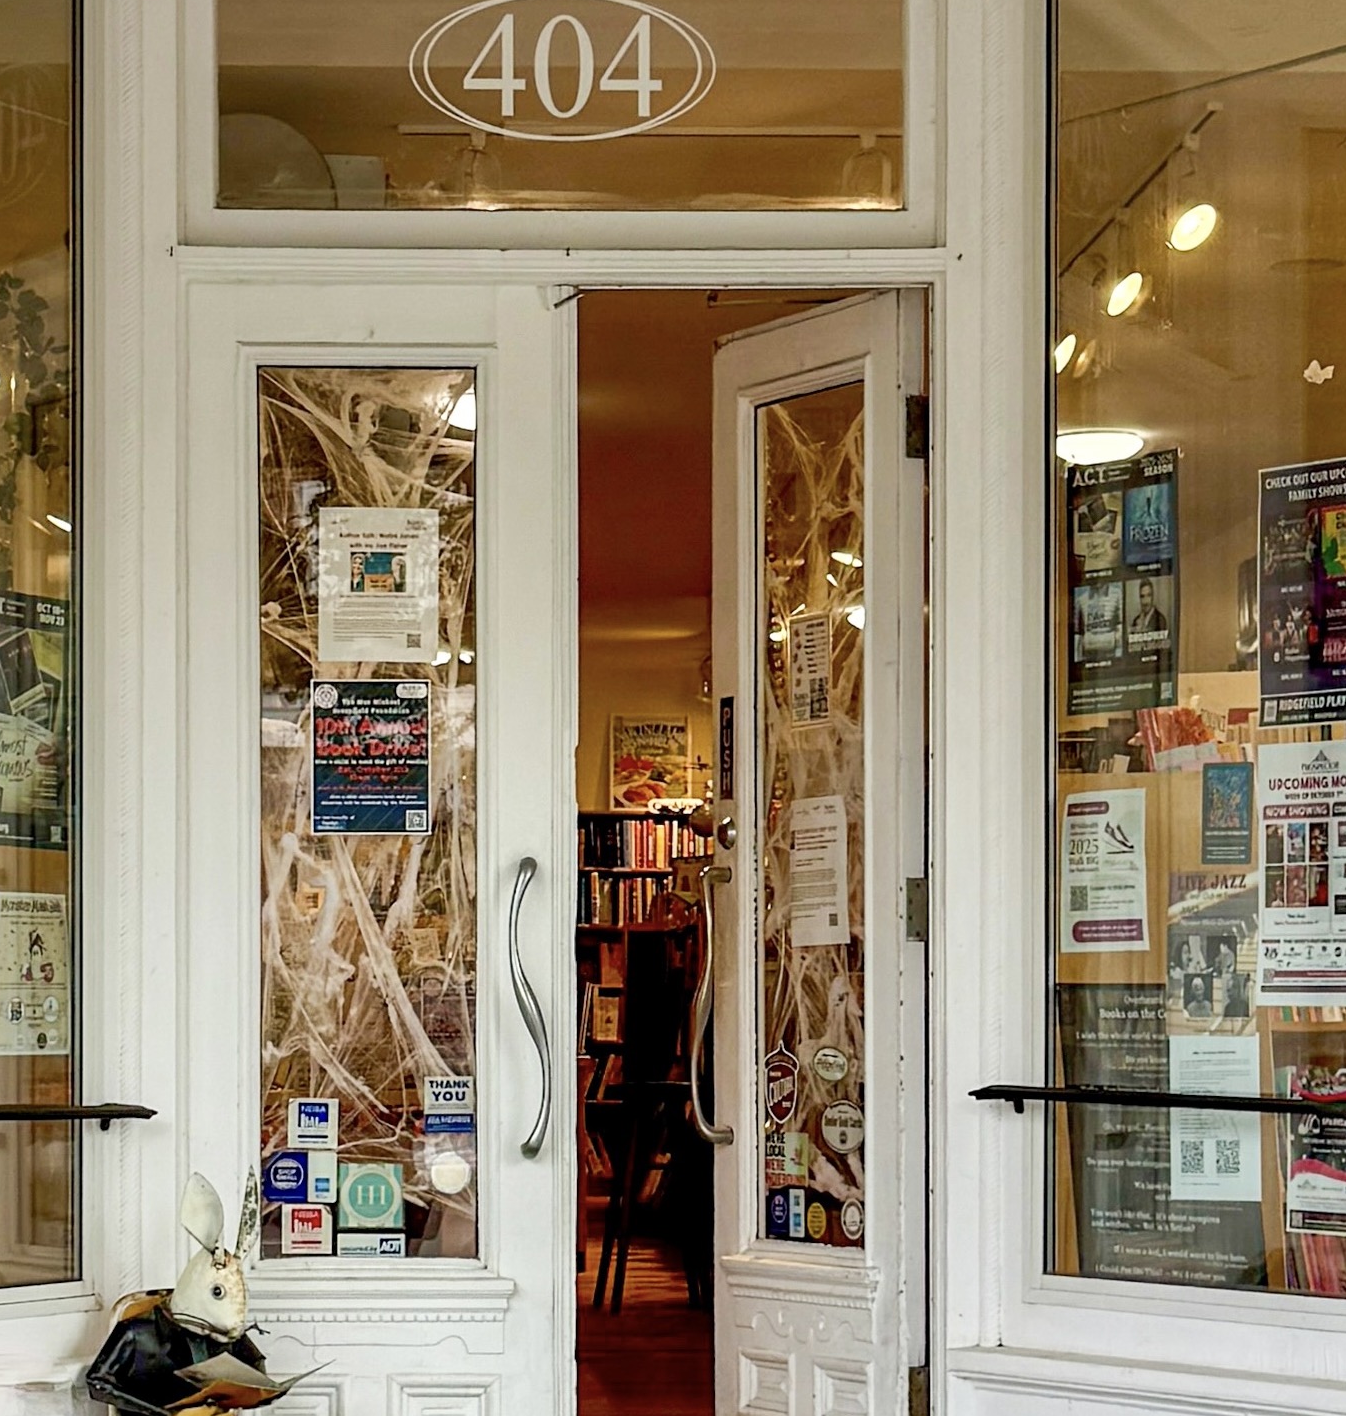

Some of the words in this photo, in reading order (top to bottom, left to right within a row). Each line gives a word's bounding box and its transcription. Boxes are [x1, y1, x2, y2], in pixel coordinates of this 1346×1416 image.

[463, 13, 663, 119] 404
[722, 706, 732, 792] PUSH
[1268, 775, 1329, 792] UPCOMING
[1068, 838, 1100, 856] 2025
[1210, 873, 1247, 890] JAZZ
[1098, 1006, 1126, 1020] Books
[1140, 1007, 1156, 1020] the
[428, 1079, 471, 1090] THANK
[431, 1090, 467, 1102] YOU
[380, 1239, 401, 1254] ADT
